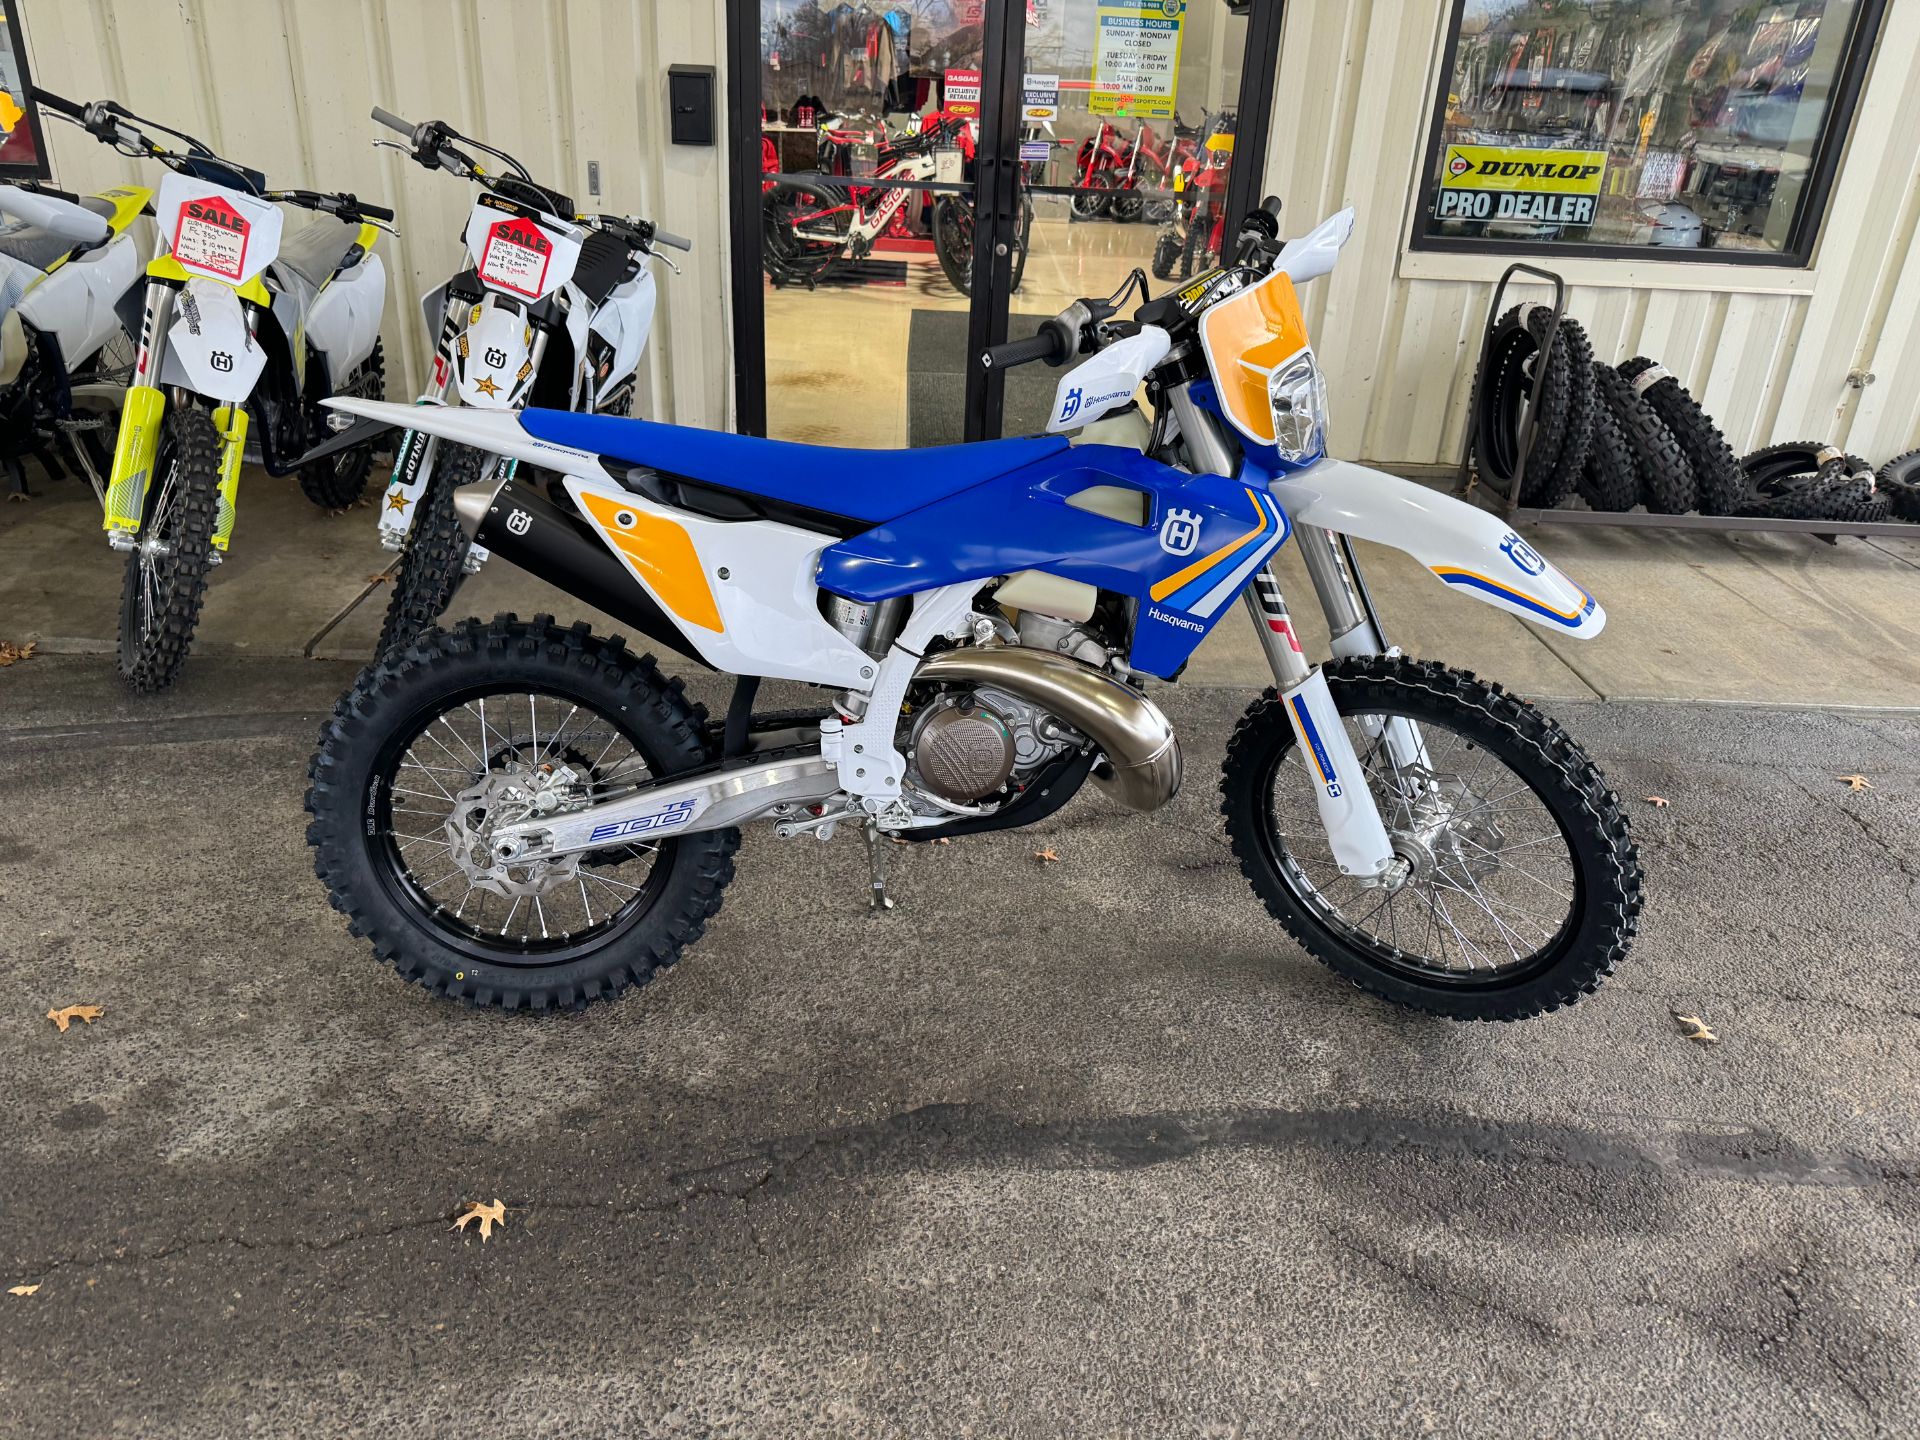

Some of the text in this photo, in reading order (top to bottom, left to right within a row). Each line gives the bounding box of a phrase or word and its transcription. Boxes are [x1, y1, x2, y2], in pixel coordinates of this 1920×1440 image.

[1108, 17, 1172, 28] BUSINESS HOURS
[1106, 29, 1135, 38] SUNDAY
[1140, 32, 1172, 40] MONDAY
[1124, 40, 1152, 48] CLOSED
[1106, 52, 1138, 60] TUESDAY
[1116, 74, 1152, 83] SATURDAY
[1094, 96, 1172, 106] TRISTATEPRSPORTS.COM
[1476, 160, 1600, 180] DUNLOP
[1440, 191, 1592, 222] PRO DEALER
[188, 204, 244, 232] SALE
[496, 224, 548, 253] SALE
[1092, 390, 1130, 405] Husqvarna
[405, 432, 426, 480] UNLOP
[544, 445, 588, 459] Husqvarna
[1148, 606, 1204, 633] Husqvarna
[663, 798, 698, 811] TE
[589, 808, 692, 842] 300
